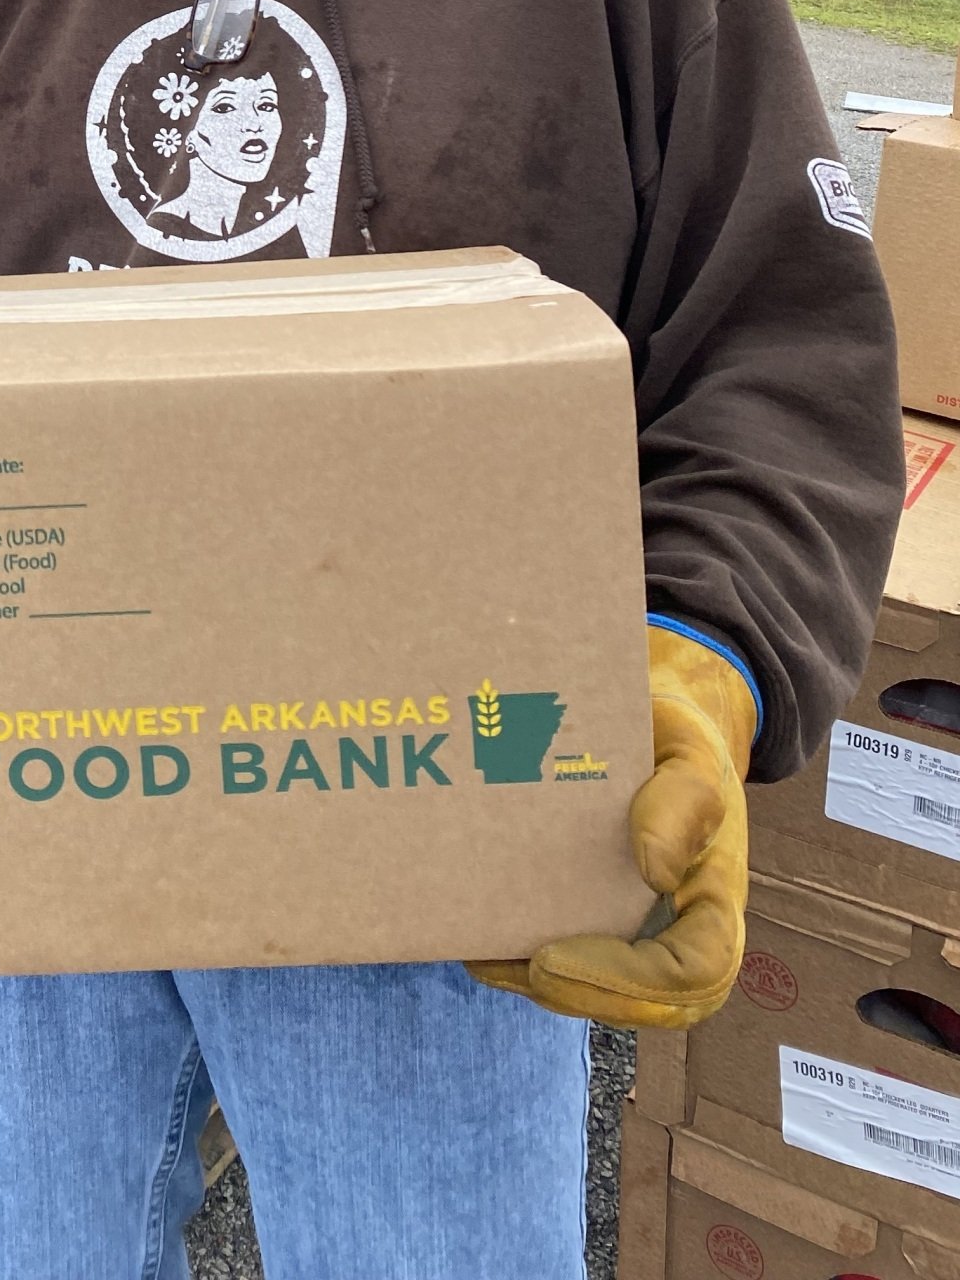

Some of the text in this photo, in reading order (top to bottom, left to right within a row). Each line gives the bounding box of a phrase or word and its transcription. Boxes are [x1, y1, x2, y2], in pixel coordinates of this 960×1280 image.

[6, 527, 65, 548] (USDA)
[3, 552, 57, 573] (Food)
[220, 695, 451, 733] ARKANSAS
[845, 731, 900, 759] 100319
[220, 733, 453, 795] BANK
[555, 770, 609, 782] AMERICA
[792, 1060, 844, 1087] 100319
